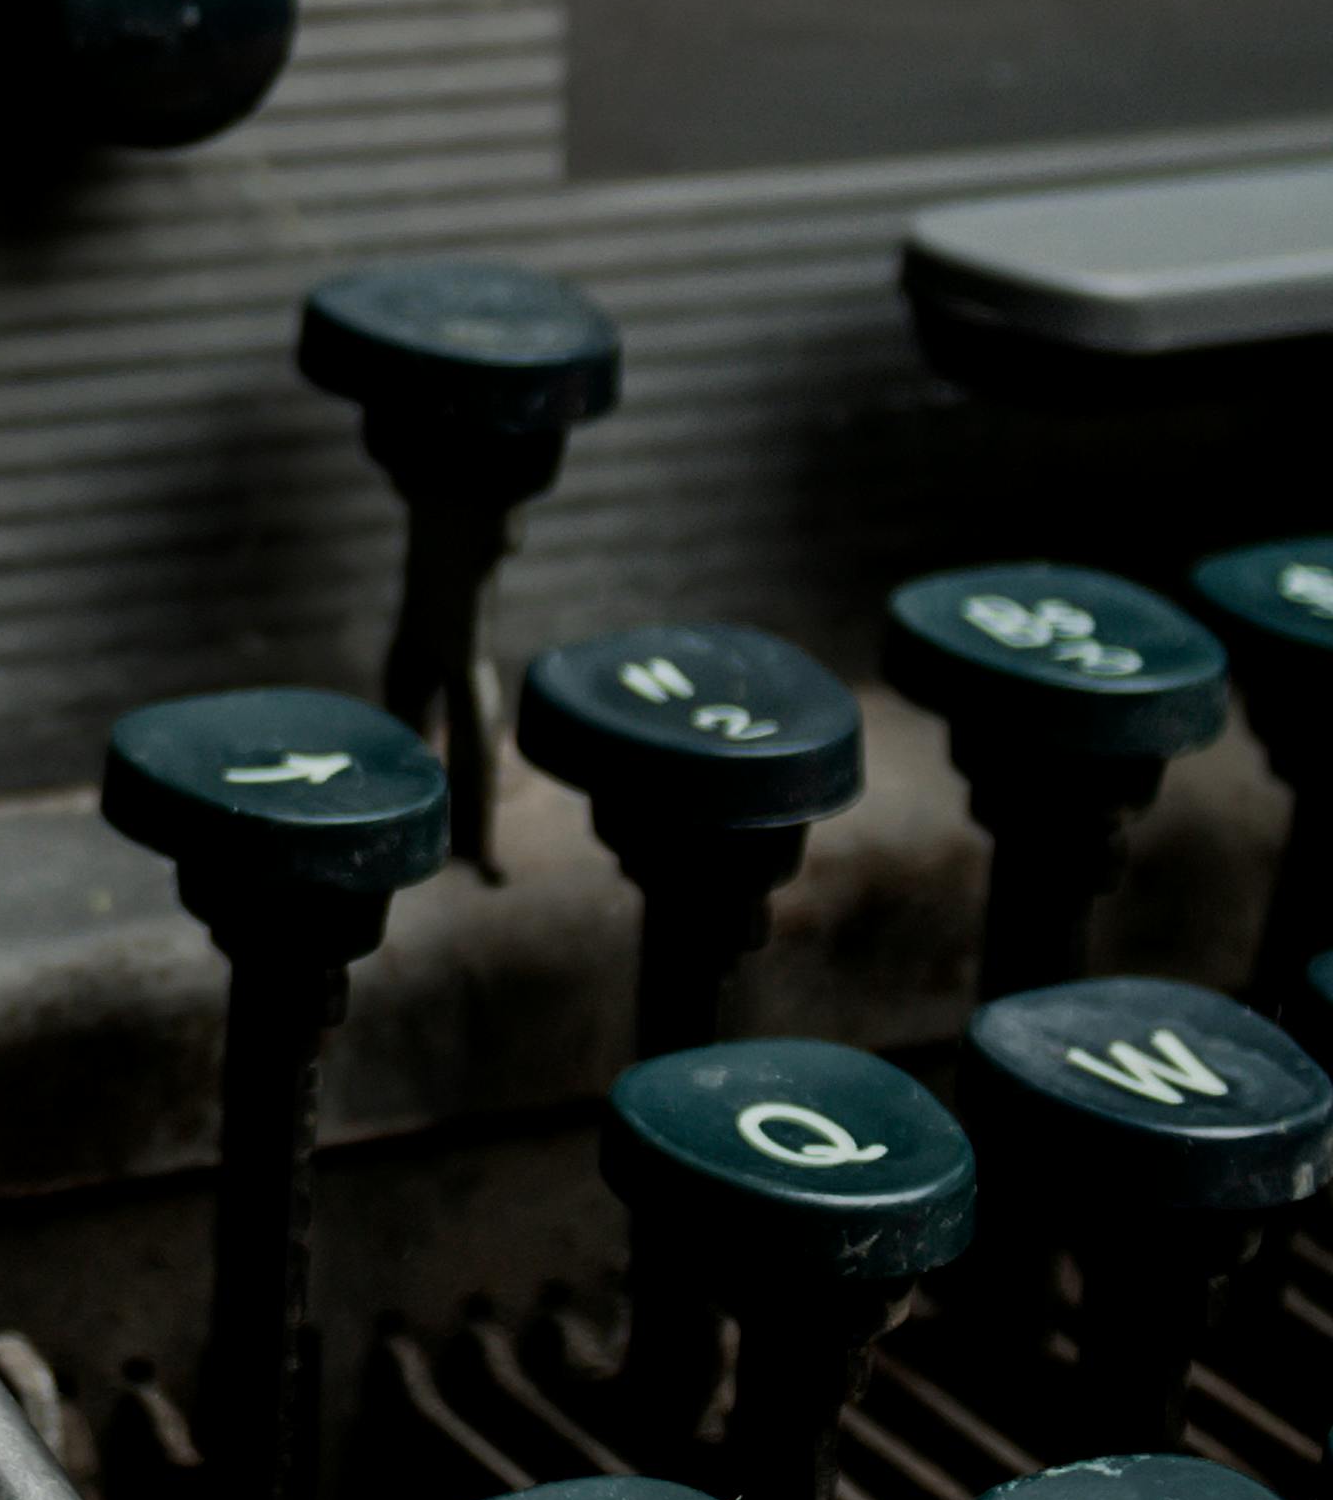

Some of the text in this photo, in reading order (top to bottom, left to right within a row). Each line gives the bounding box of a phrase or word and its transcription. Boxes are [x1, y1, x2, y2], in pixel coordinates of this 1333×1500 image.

[692, 703, 778, 741] 2
[1067, 1028, 1229, 1106] W
[737, 1102, 888, 1168] Q
